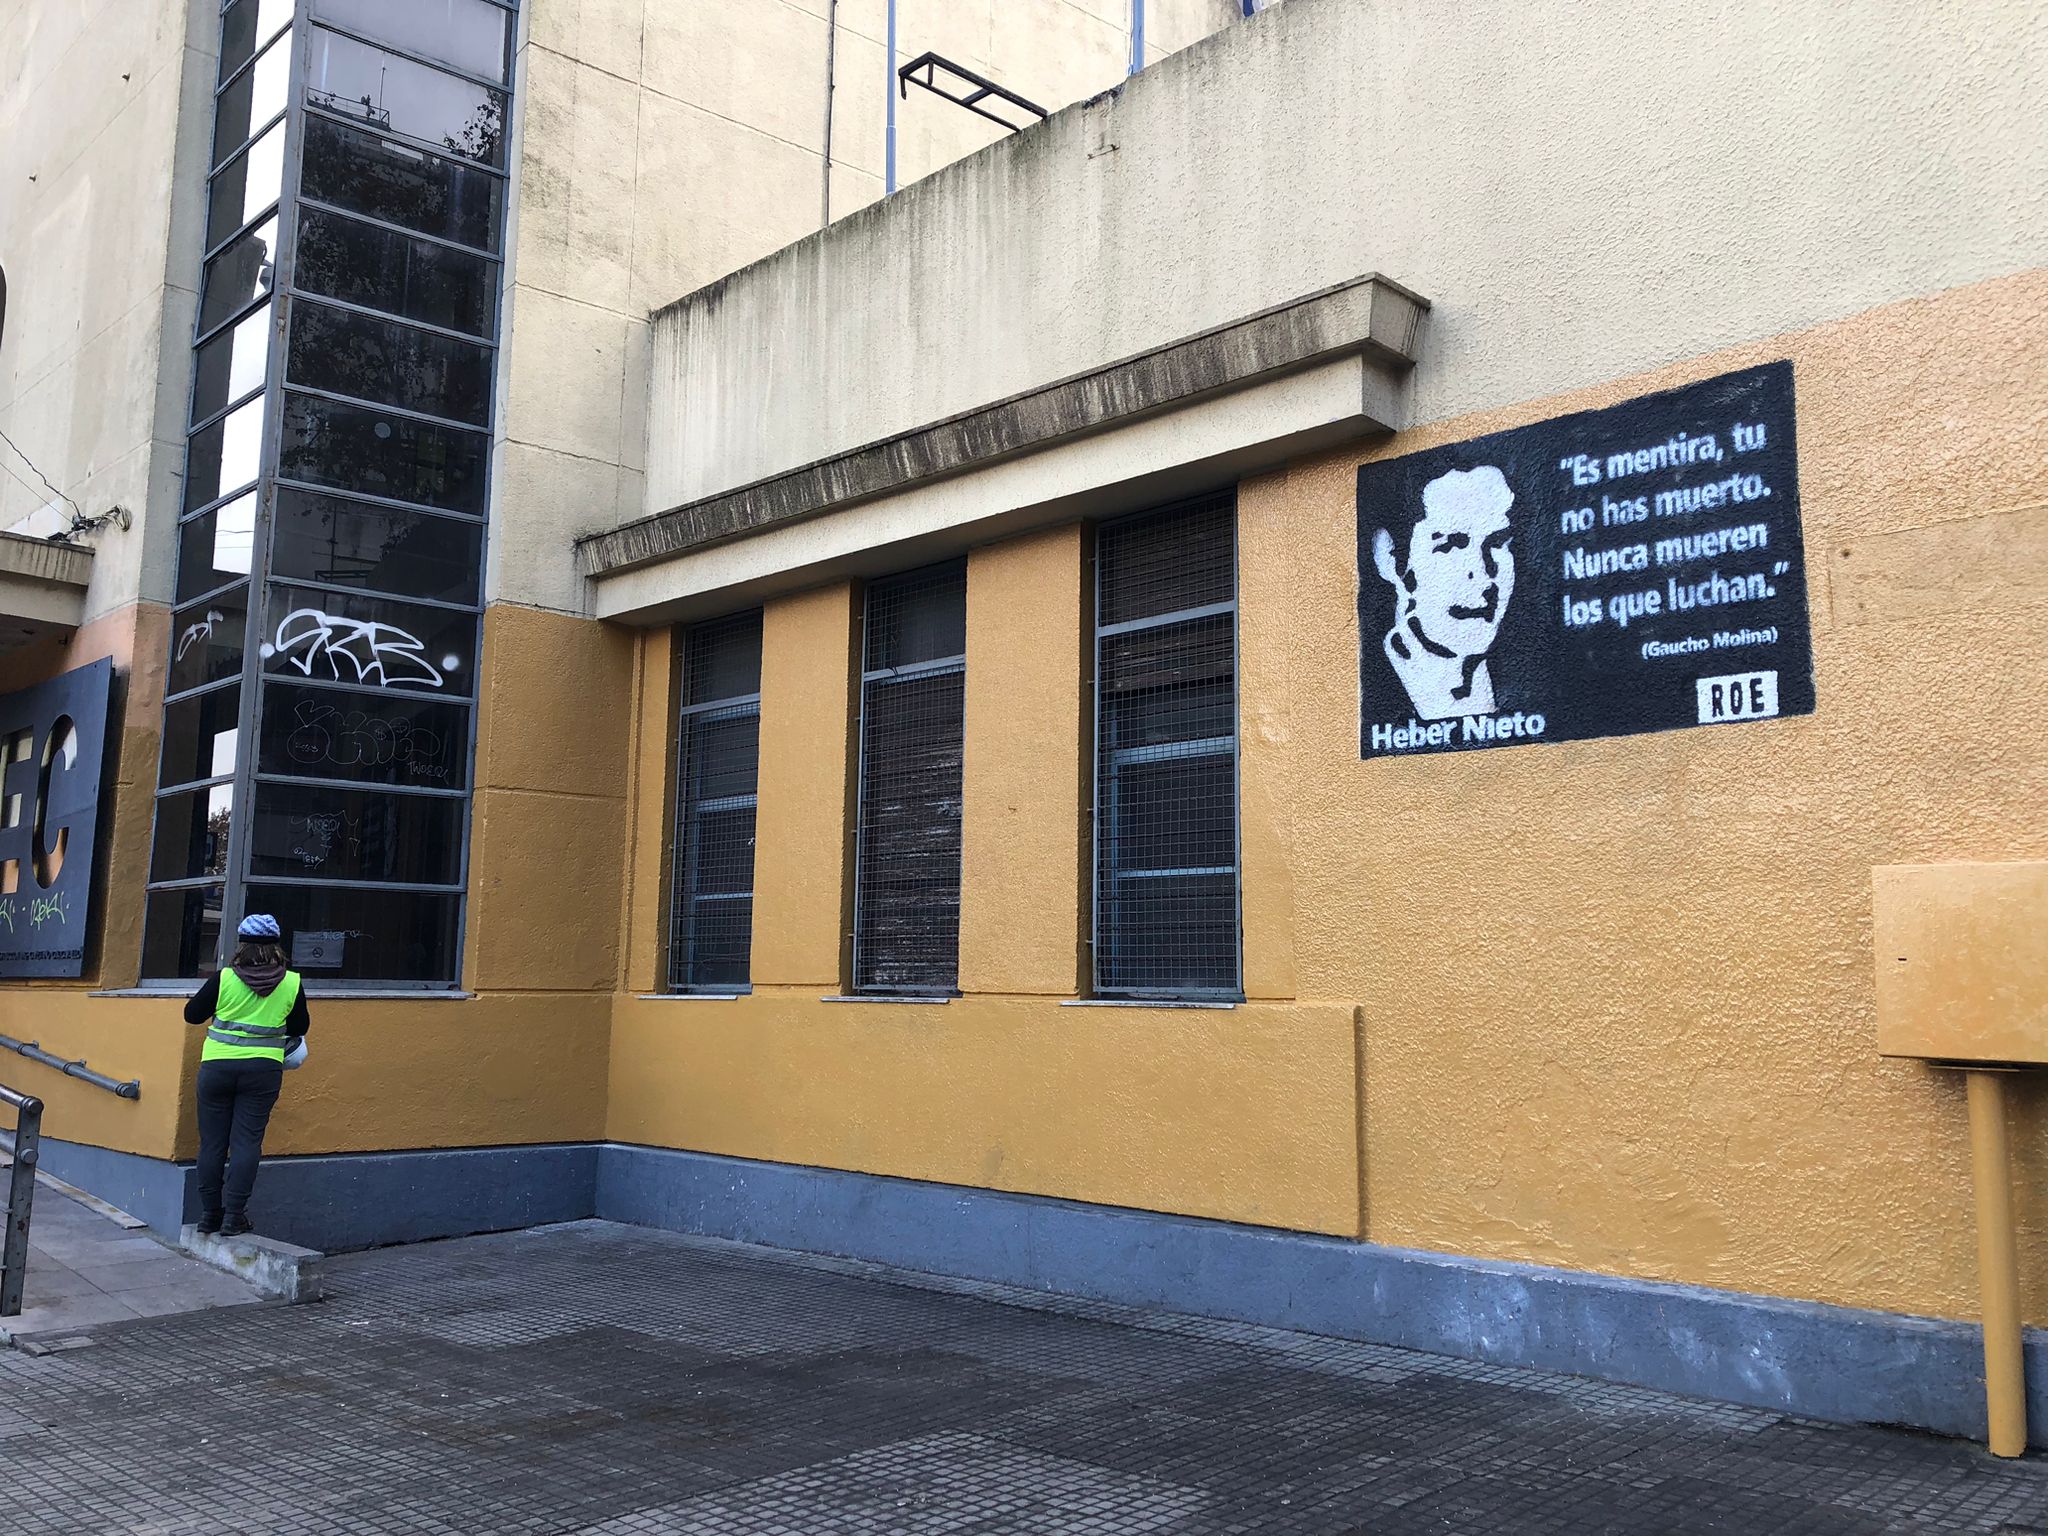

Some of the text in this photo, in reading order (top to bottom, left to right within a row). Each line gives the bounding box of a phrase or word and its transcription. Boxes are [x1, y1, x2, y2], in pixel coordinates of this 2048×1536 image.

[1561, 423, 1766, 485] "Es mentira, tu
[1562, 473, 1772, 534] no has muerto.
[1564, 524, 1768, 579] Nunca mueren
[1563, 561, 1790, 627] los que luchan."
[1642, 626, 1778, 659] (Gaucho Molina)
[1710, 679, 1765, 716] ROE
[1372, 712, 1546, 749] Heber Nieto
